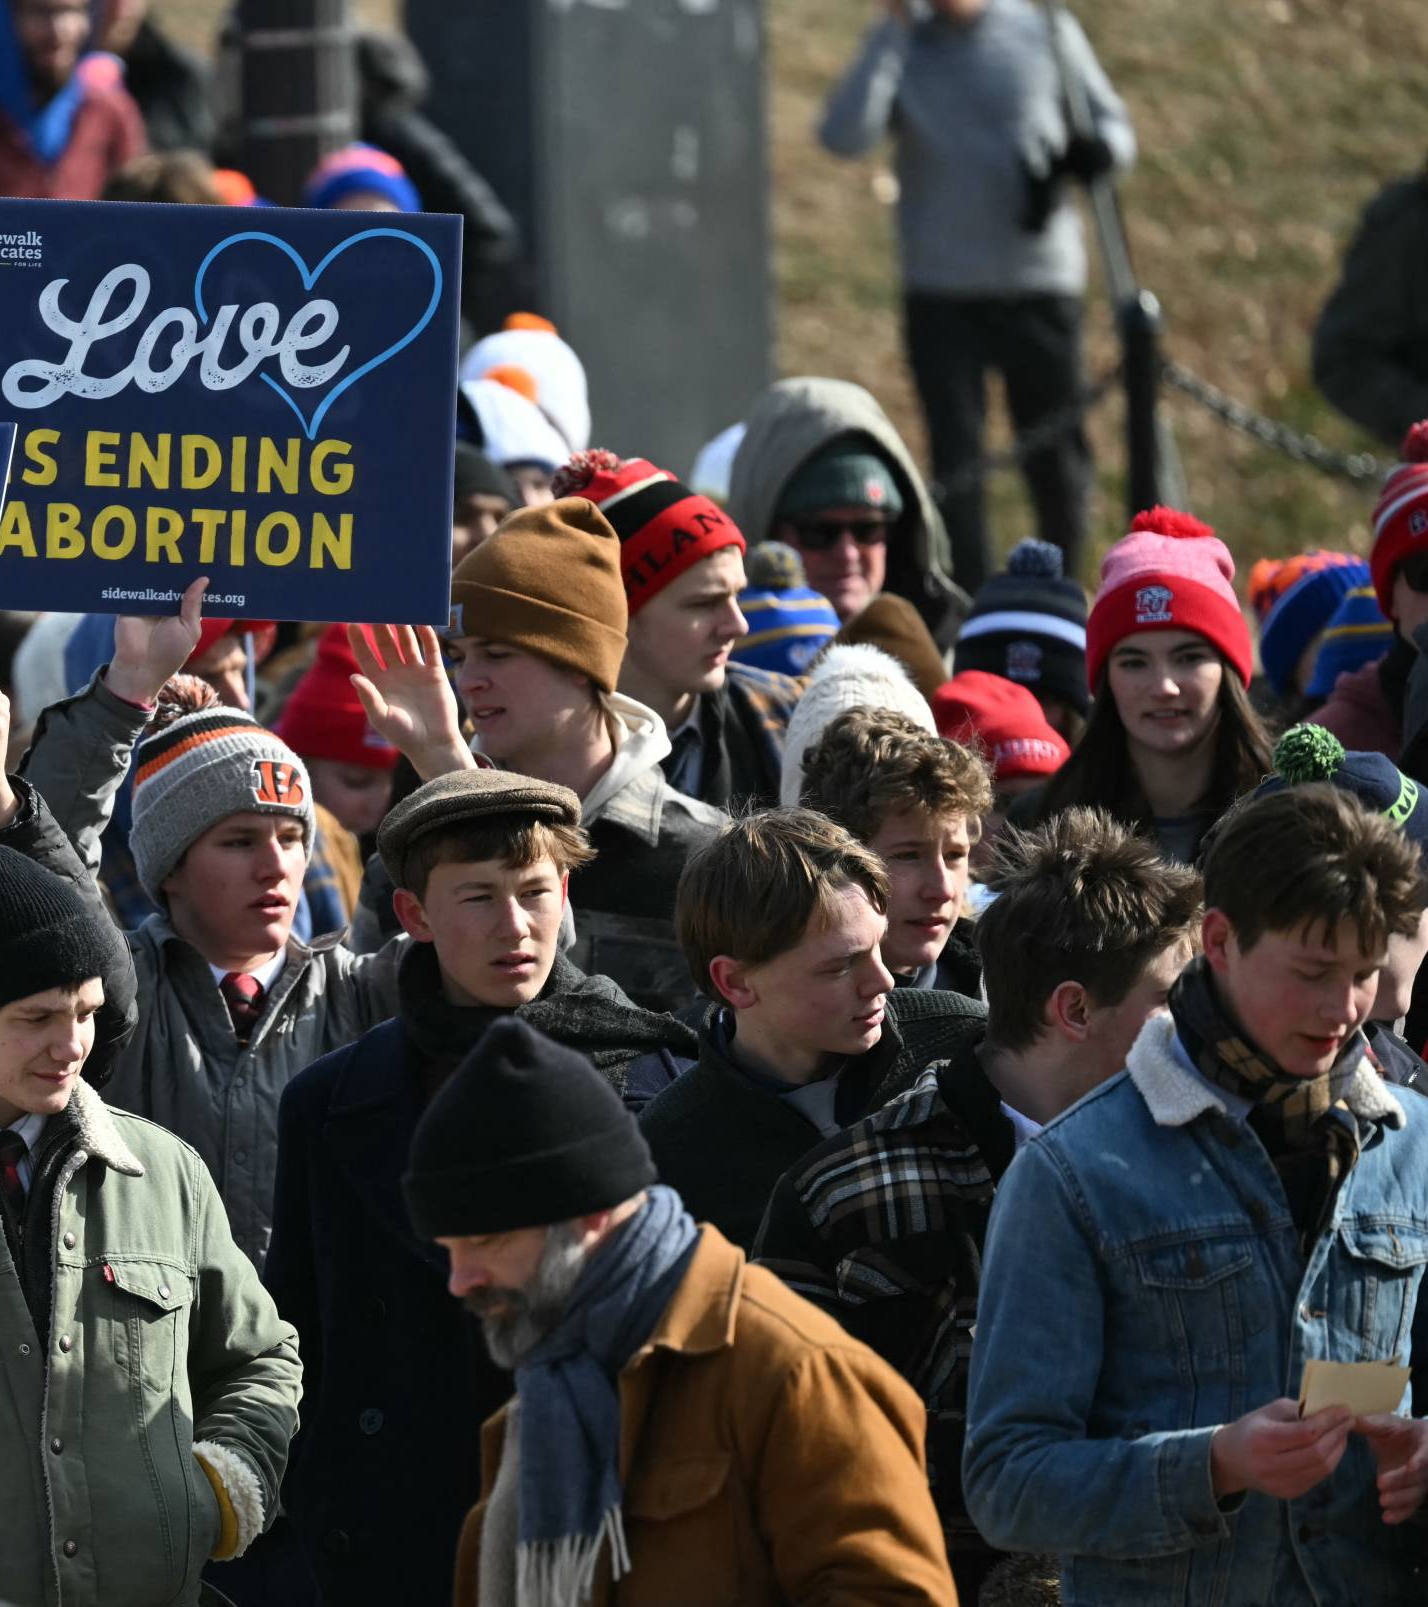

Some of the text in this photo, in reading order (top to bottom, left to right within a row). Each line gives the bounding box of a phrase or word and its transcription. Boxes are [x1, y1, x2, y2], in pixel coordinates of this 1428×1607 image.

[2, 263, 351, 409] Love
[8, 428, 355, 495] S ENDING
[101, 587, 246, 607] sidewalkadvtes.org
